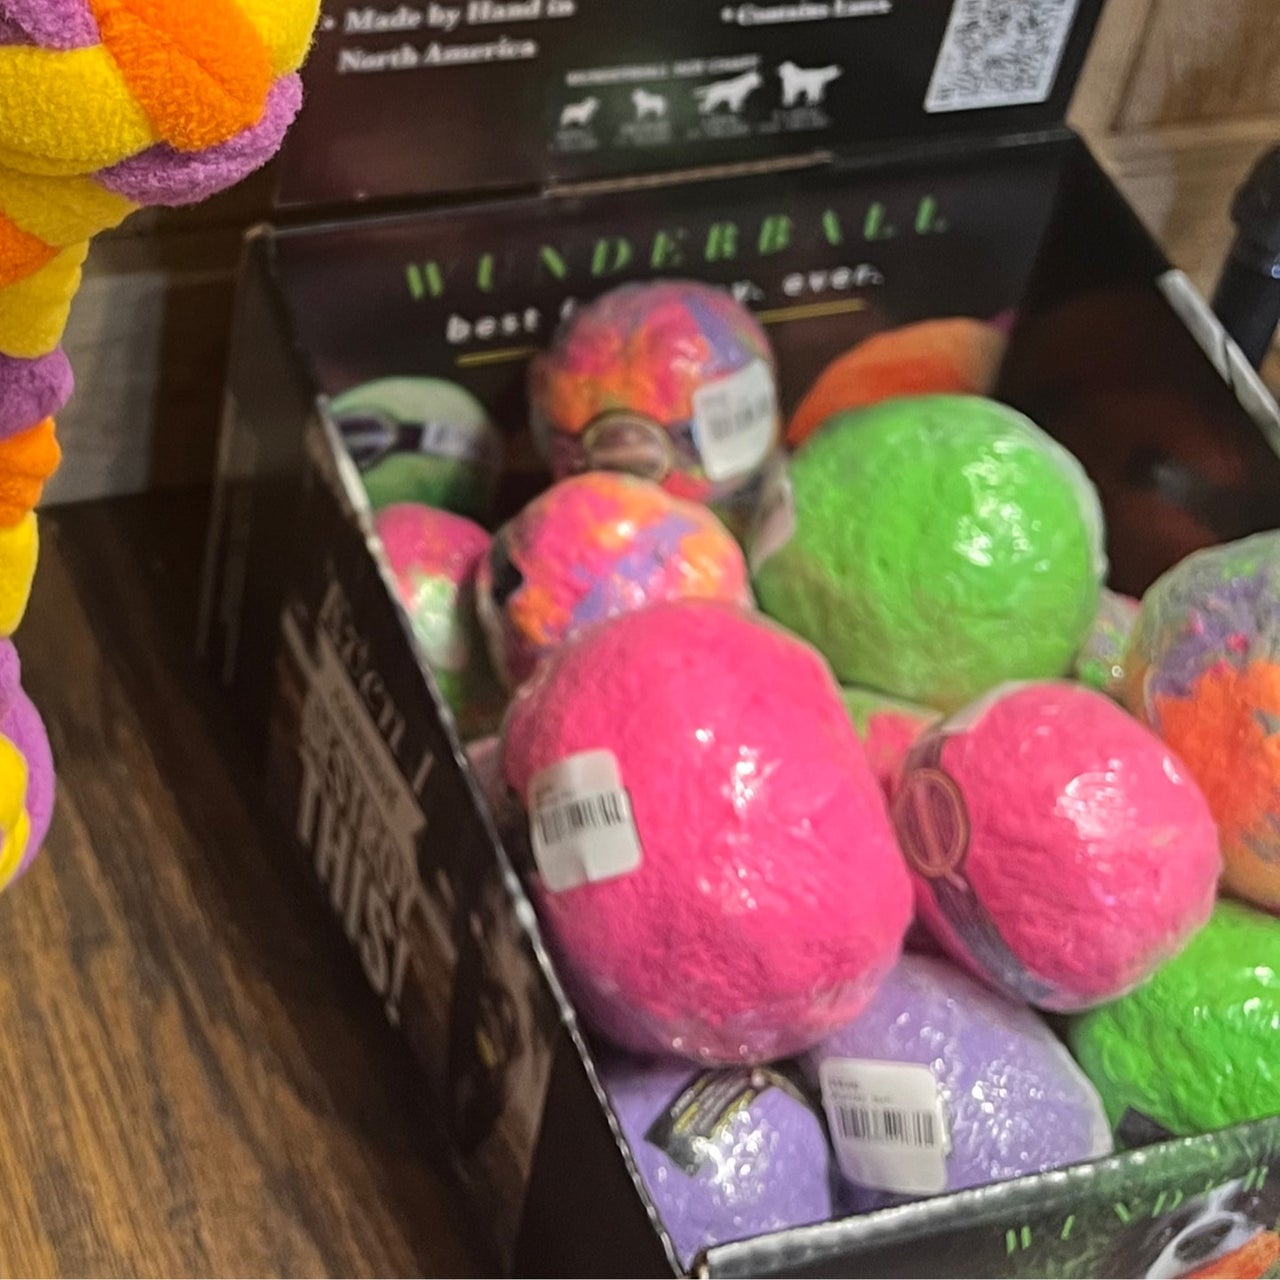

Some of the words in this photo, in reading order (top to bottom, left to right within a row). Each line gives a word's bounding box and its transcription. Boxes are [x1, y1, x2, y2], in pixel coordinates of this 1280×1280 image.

[343, 5, 423, 35] Made
[425, 1, 461, 32] by
[336, 41, 420, 73] North
[422, 34, 539, 67] America
[445, 304, 541, 345] best
